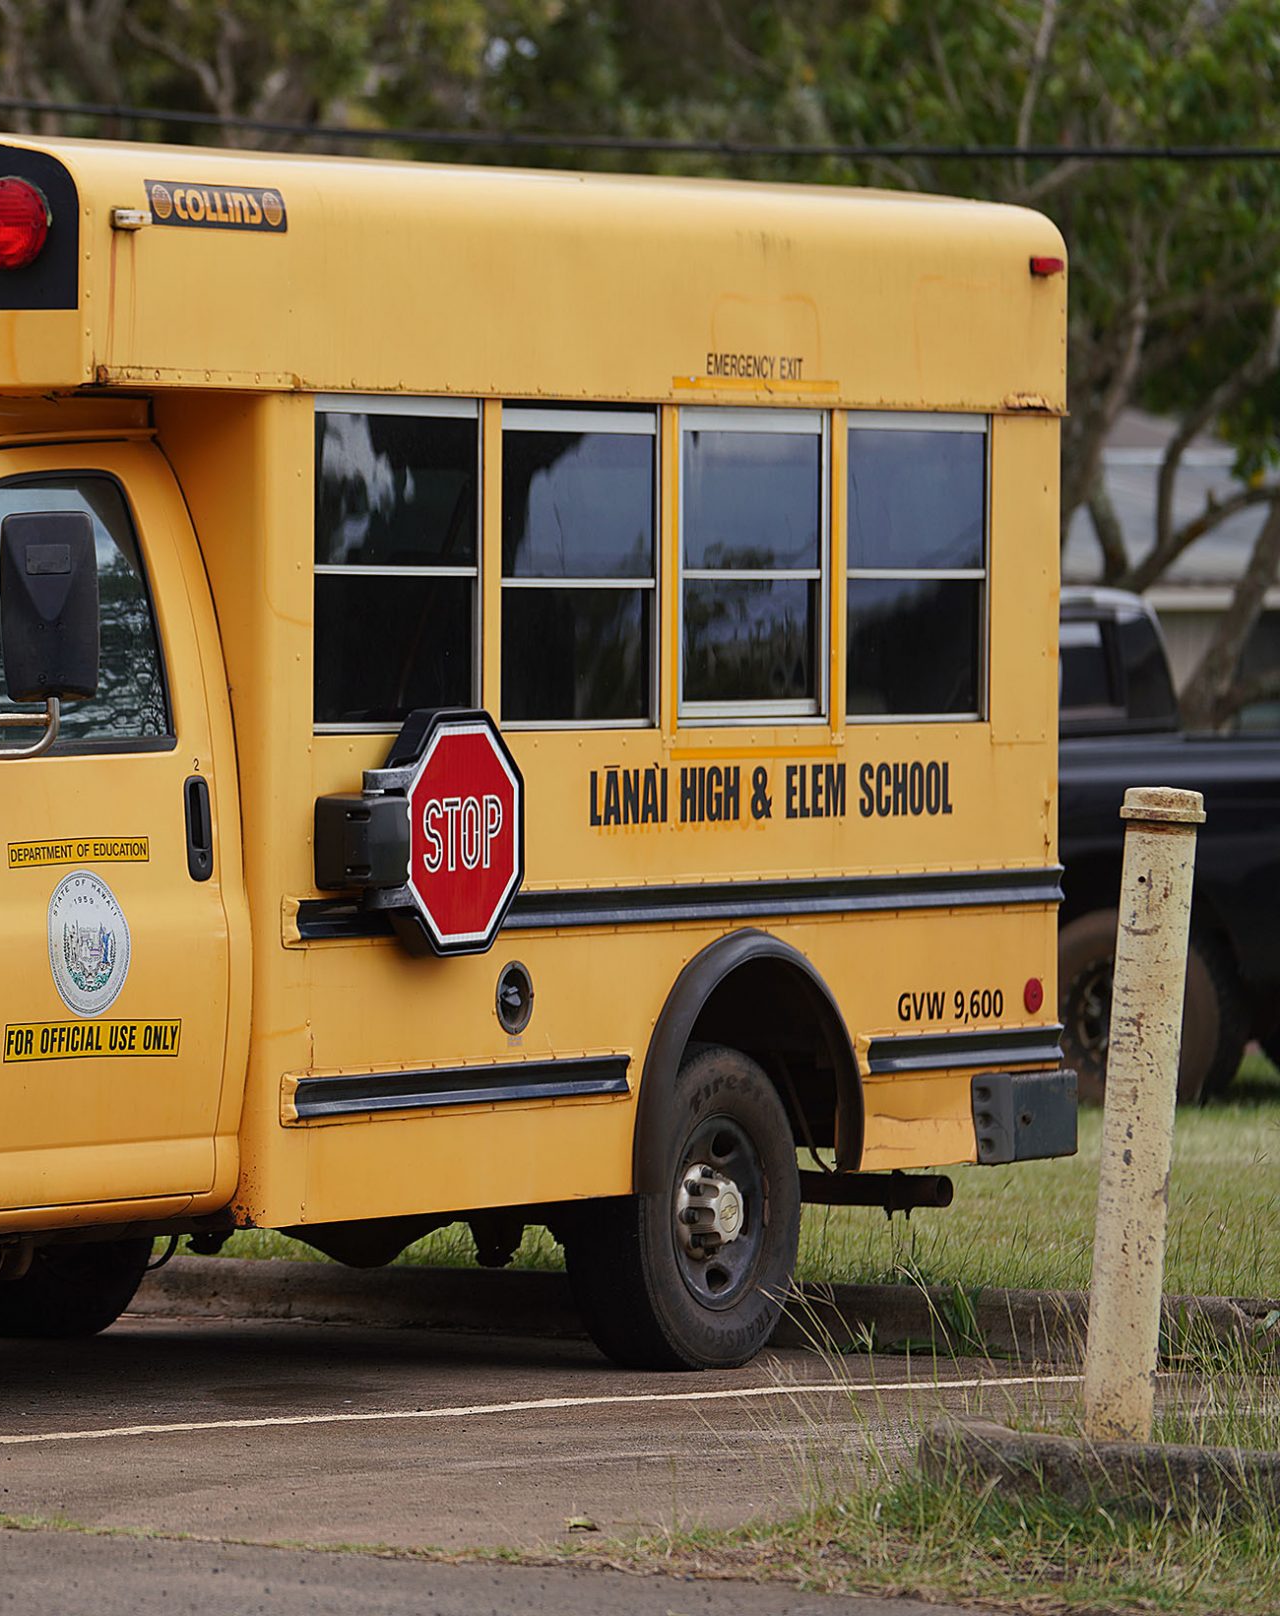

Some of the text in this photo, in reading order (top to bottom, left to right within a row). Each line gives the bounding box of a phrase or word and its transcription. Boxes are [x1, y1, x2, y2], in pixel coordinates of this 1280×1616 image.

[173, 188, 263, 225] COLLINS
[706, 352, 804, 380] EMERGENCY EXIT
[192, 757, 200, 772] 2
[680, 765, 741, 823] HIGH
[750, 765, 773, 821] &
[785, 763, 847, 820] ELEM
[859, 760, 953, 818] SCHOOL
[422, 793, 503, 873] STOP
[10, 840, 147, 863] DEPARTMENT OF EDUCATION
[53, 878, 119, 917] STATE OF HAWAII
[73, 895, 95, 906] 1959
[897, 989, 1004, 1024] GVW 9,600
[6, 1023, 179, 1057] FOR OFFICIAL USE ONLY
